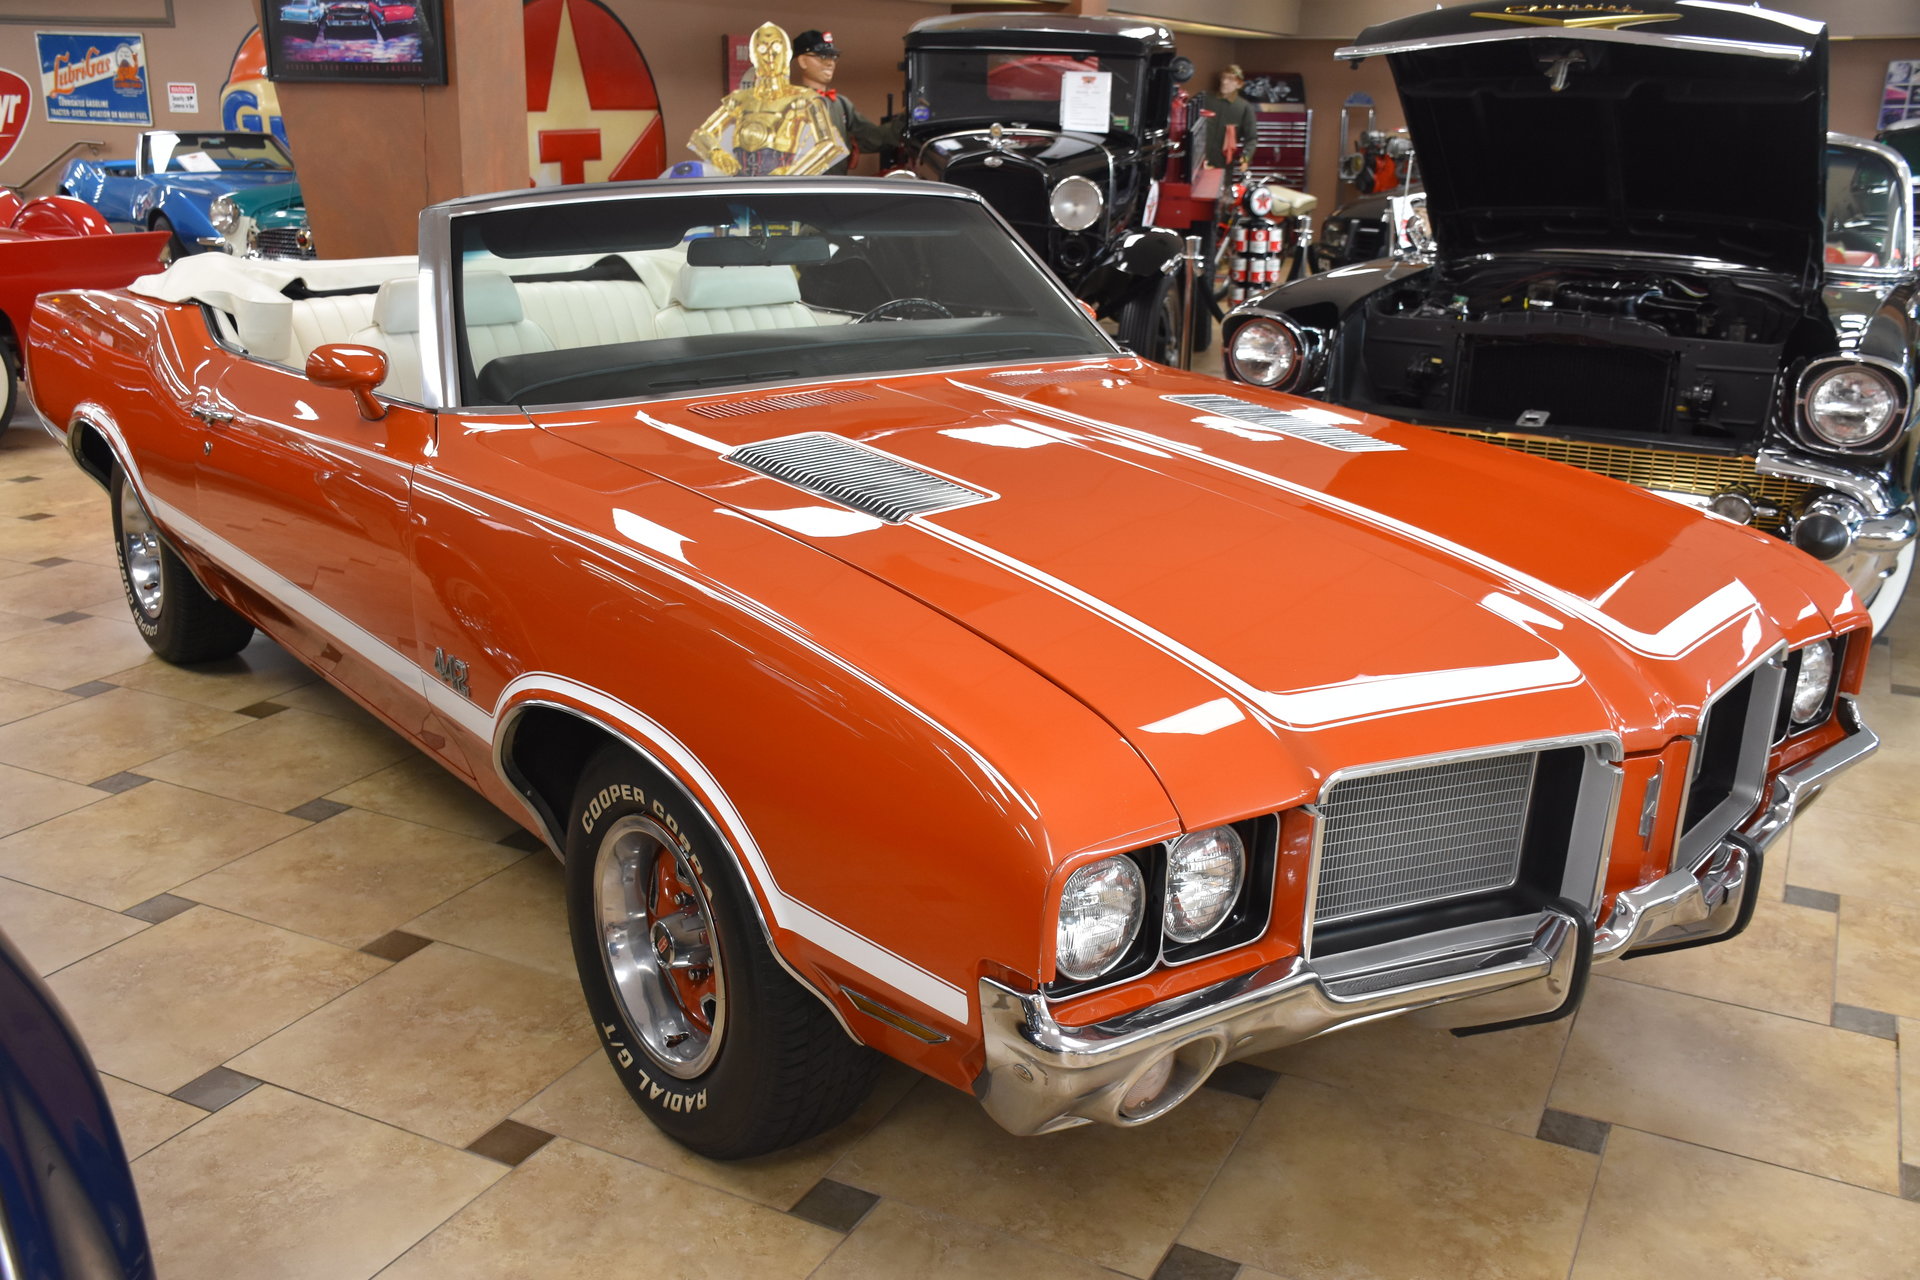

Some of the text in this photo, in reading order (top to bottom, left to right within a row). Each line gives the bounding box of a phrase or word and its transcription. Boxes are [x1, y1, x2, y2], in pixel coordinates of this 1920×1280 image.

[582, 784, 647, 834] COOPER
[601, 1022, 707, 1113] RADIAL G/T
